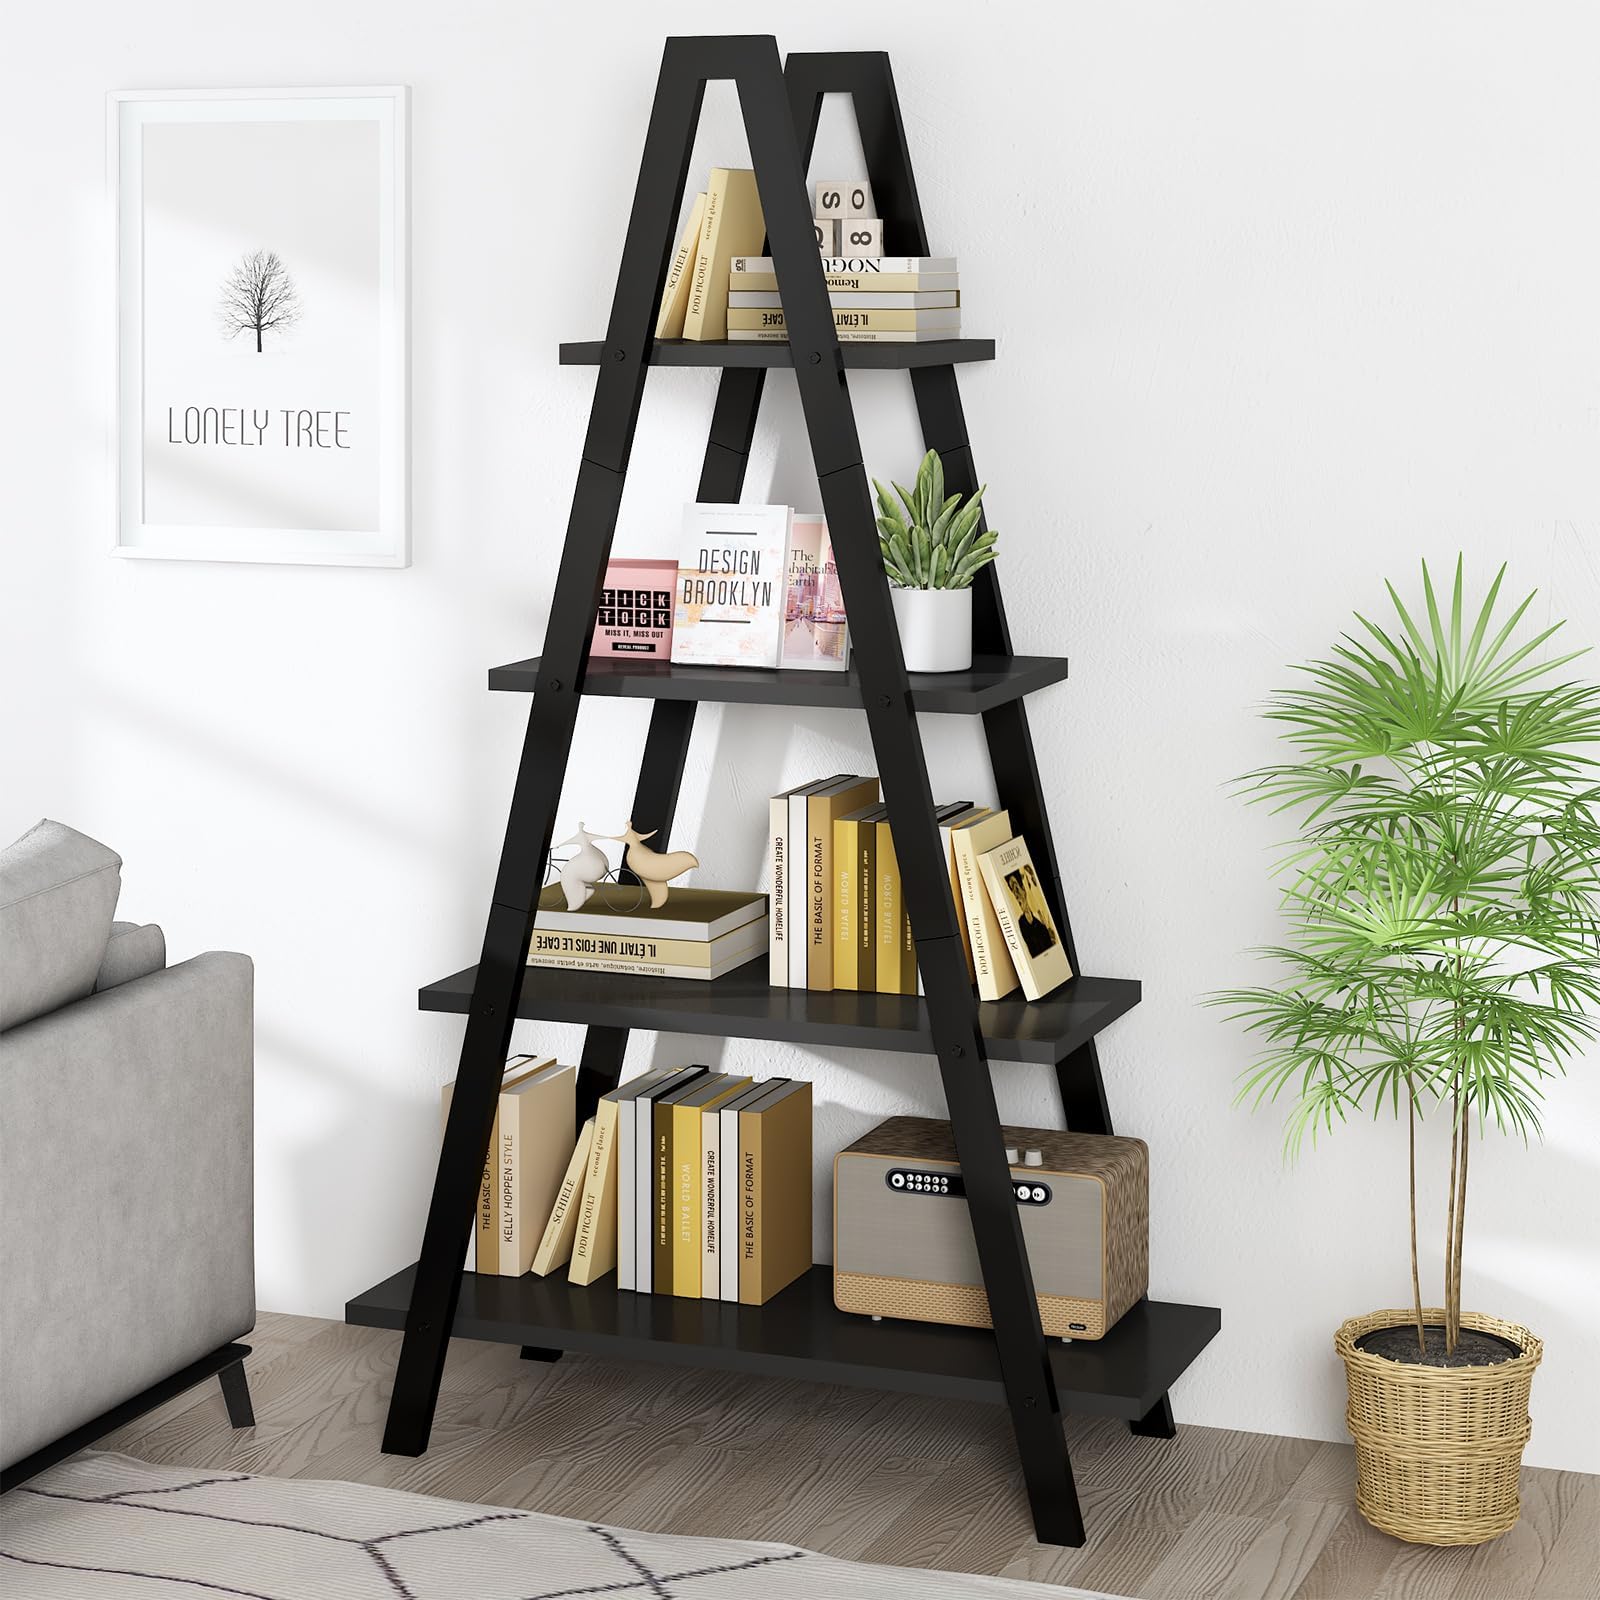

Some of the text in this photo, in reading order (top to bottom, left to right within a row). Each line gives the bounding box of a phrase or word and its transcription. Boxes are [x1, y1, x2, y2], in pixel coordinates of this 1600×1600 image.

[822, 191, 841, 209] S
[704, 192, 718, 240] second glance
[850, 231, 872, 246] 8
[668, 246, 689, 290] SCHIELE
[691, 254, 709, 315] JODI PICOULT
[762, 313, 784, 327] CAFÉ
[836, 313, 869, 328] IL ÉTAIT
[168, 405, 351, 449] LONELY TREE
[698, 548, 761, 576] DESIGN
[791, 549, 814, 561] The
[603, 592, 666, 607] TICK
[683, 579, 772, 607] BROOKLYN
[603, 610, 666, 626] TOCK
[623, 630, 631, 638] IT,
[633, 630, 649, 638] MISS
[775, 836, 783, 942] CREATE WONDERFUL HOMELIFE
[814, 837, 823, 945] THE BASIC OF FORMAT
[536, 935, 657, 959] IL ÉTAIT UNE FOIS LE CAFÉ
[592, 1126, 606, 1177] second glance
[482, 1167, 490, 1181] OF
[482, 1183, 491, 1210] BASIC
[503, 1134, 513, 1243] KELLY HOPPEN STYLE
[552, 1178, 575, 1224] SCHIELE
[707, 1150, 715, 1254] CREATE WONDERFUL HOMELIFE
[681, 1163, 691, 1243] WORLD BALLET
[745, 1152, 754, 1260] THE BASIC OF FORMAT
[482, 1212, 491, 1230] THE
[578, 1192, 595, 1258] JODI PICOULT
